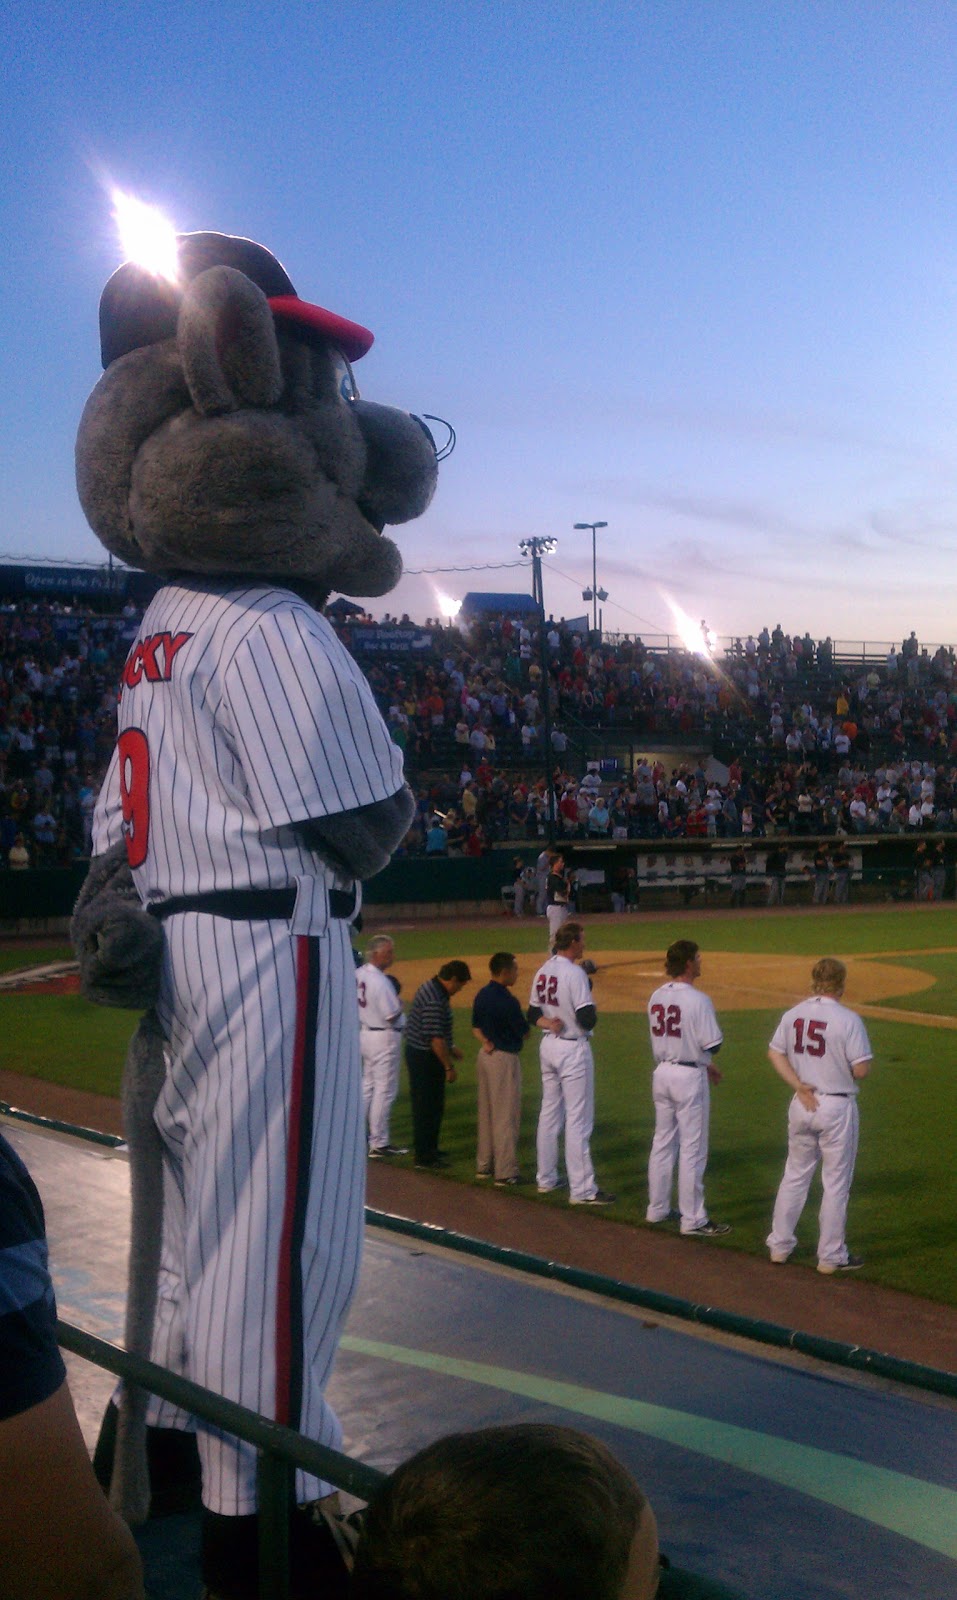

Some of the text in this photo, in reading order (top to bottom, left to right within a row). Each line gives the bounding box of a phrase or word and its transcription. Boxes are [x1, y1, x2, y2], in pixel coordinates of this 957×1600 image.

[118, 727, 150, 869] 9
[536, 974, 559, 1007] 22
[651, 1004, 682, 1038] 32
[793, 1018, 828, 1058] 15
